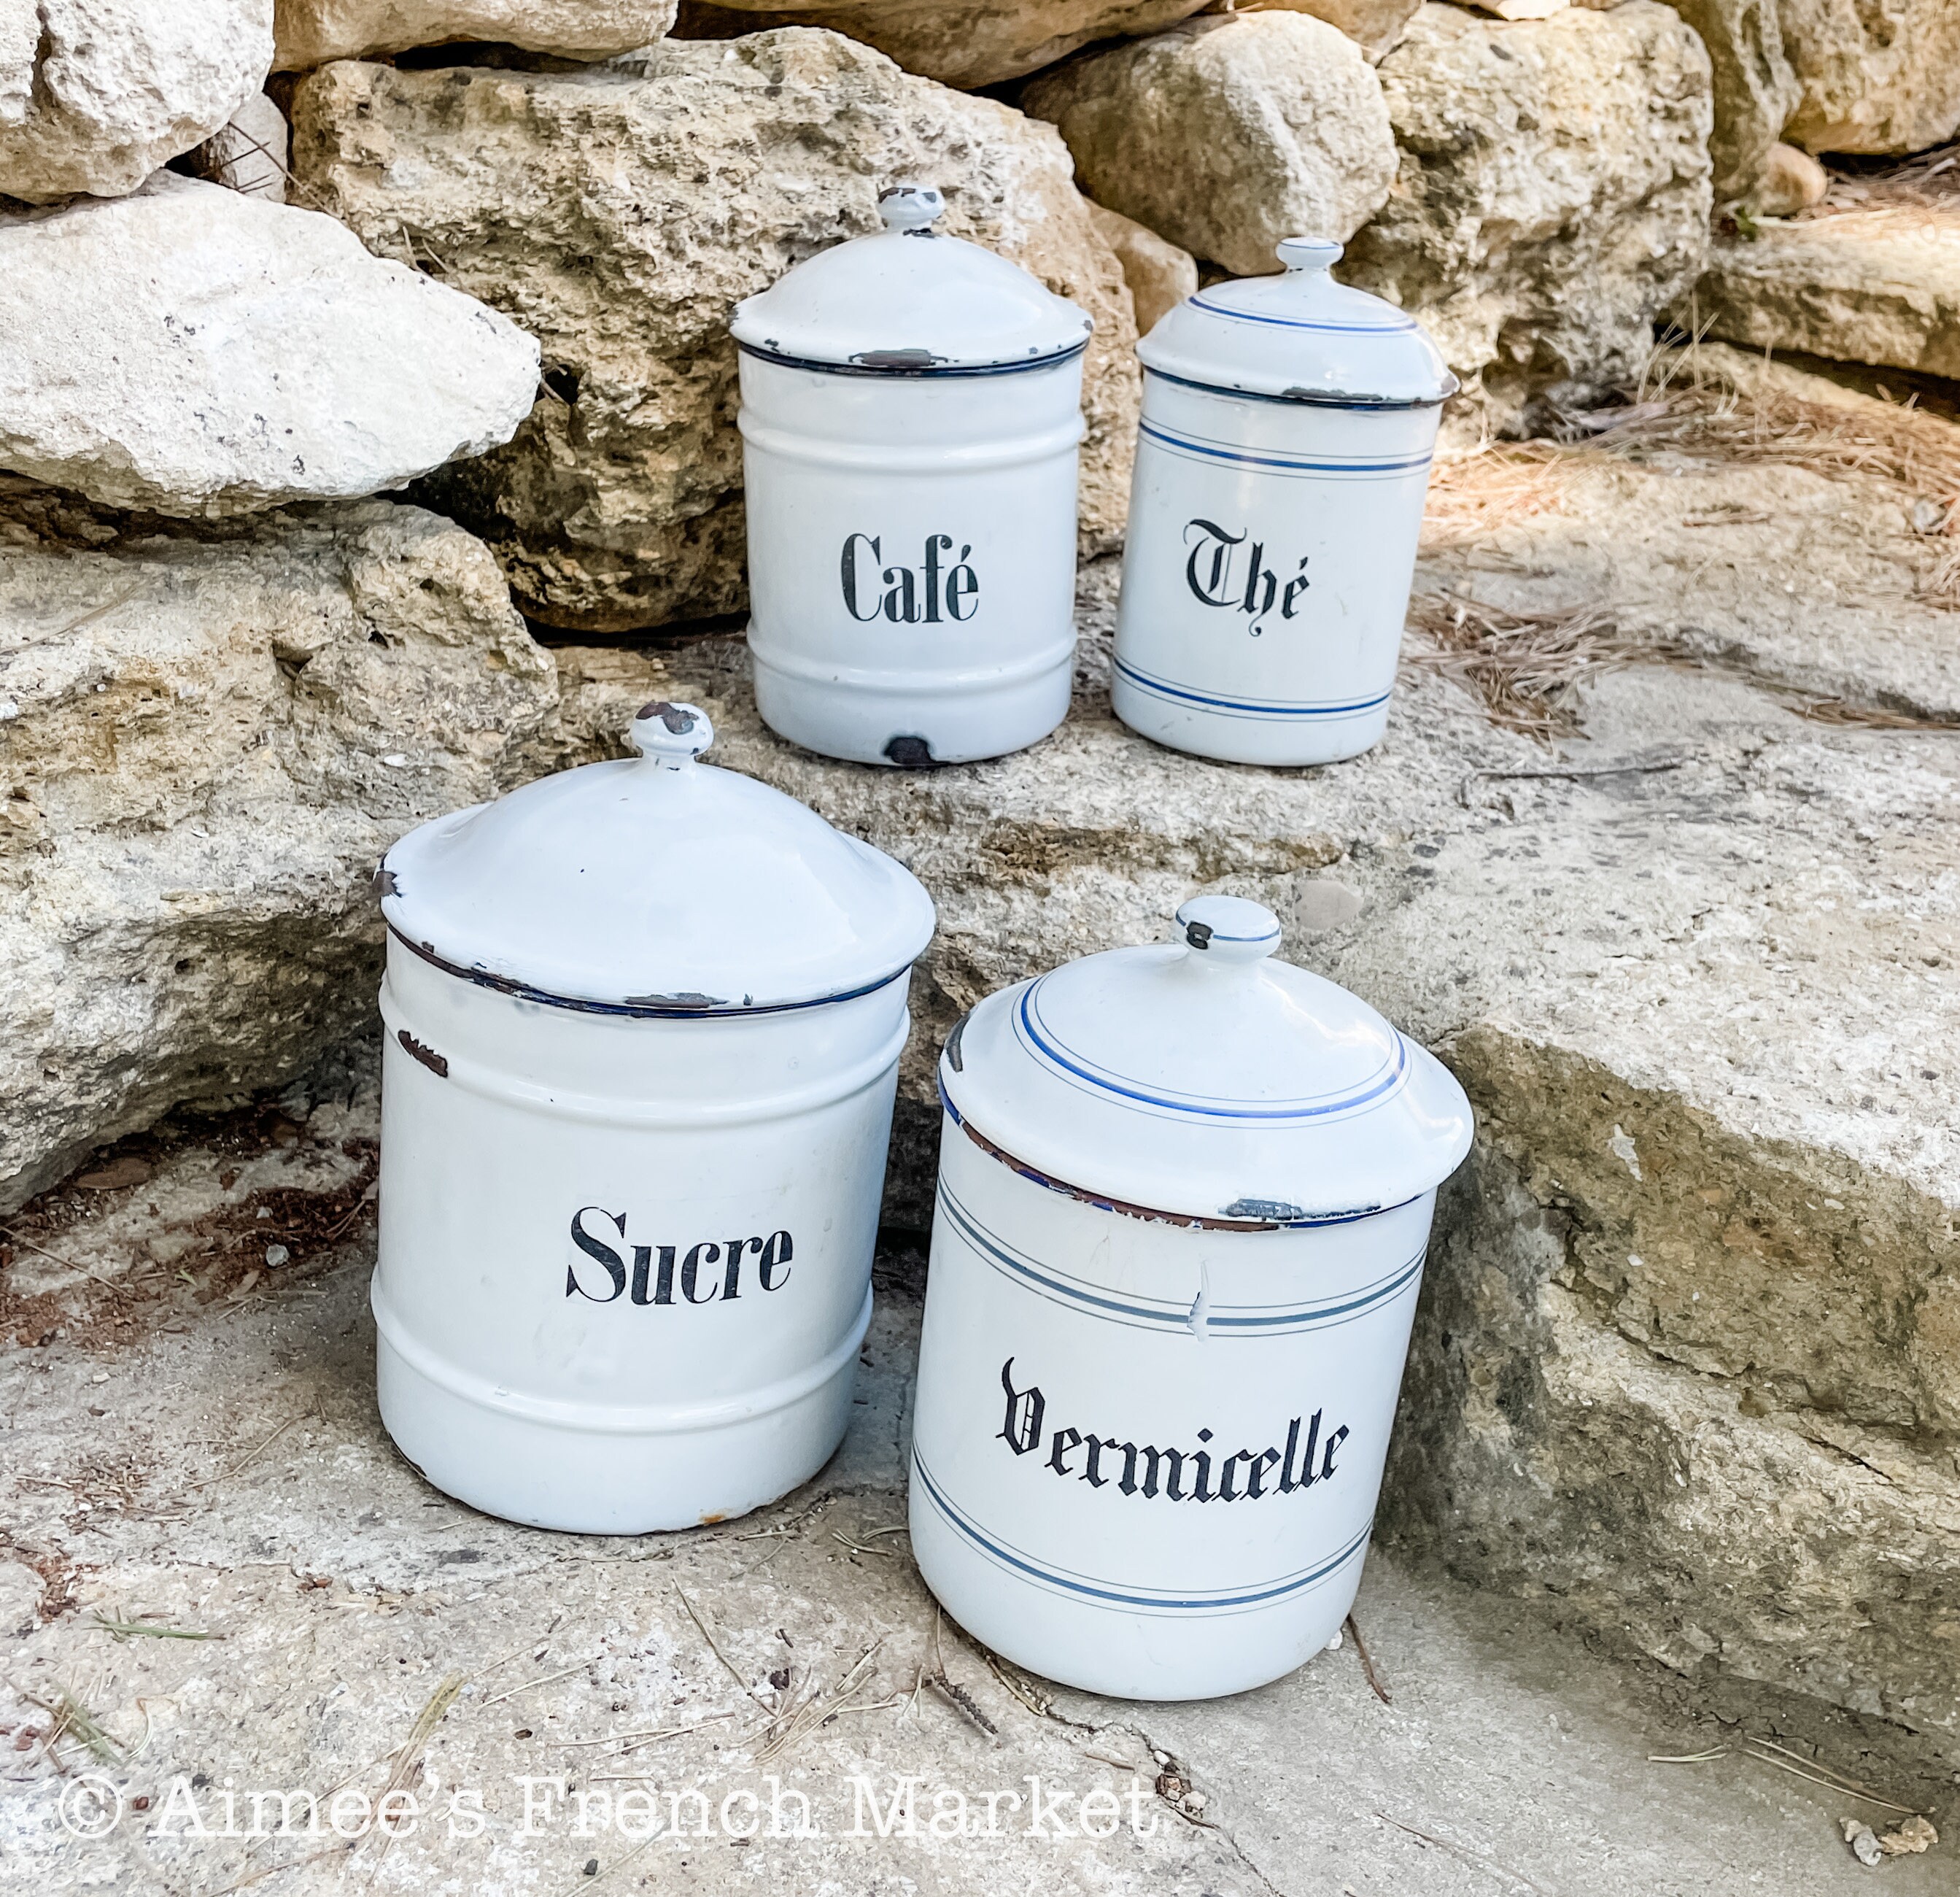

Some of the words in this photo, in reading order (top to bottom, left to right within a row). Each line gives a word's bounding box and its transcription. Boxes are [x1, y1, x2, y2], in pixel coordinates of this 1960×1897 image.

[840, 533, 980, 624] Café
[1182, 519, 1310, 637] Thé
[565, 1206, 794, 1305] Sucre
[994, 1356, 1350, 1504] Vermicelle
